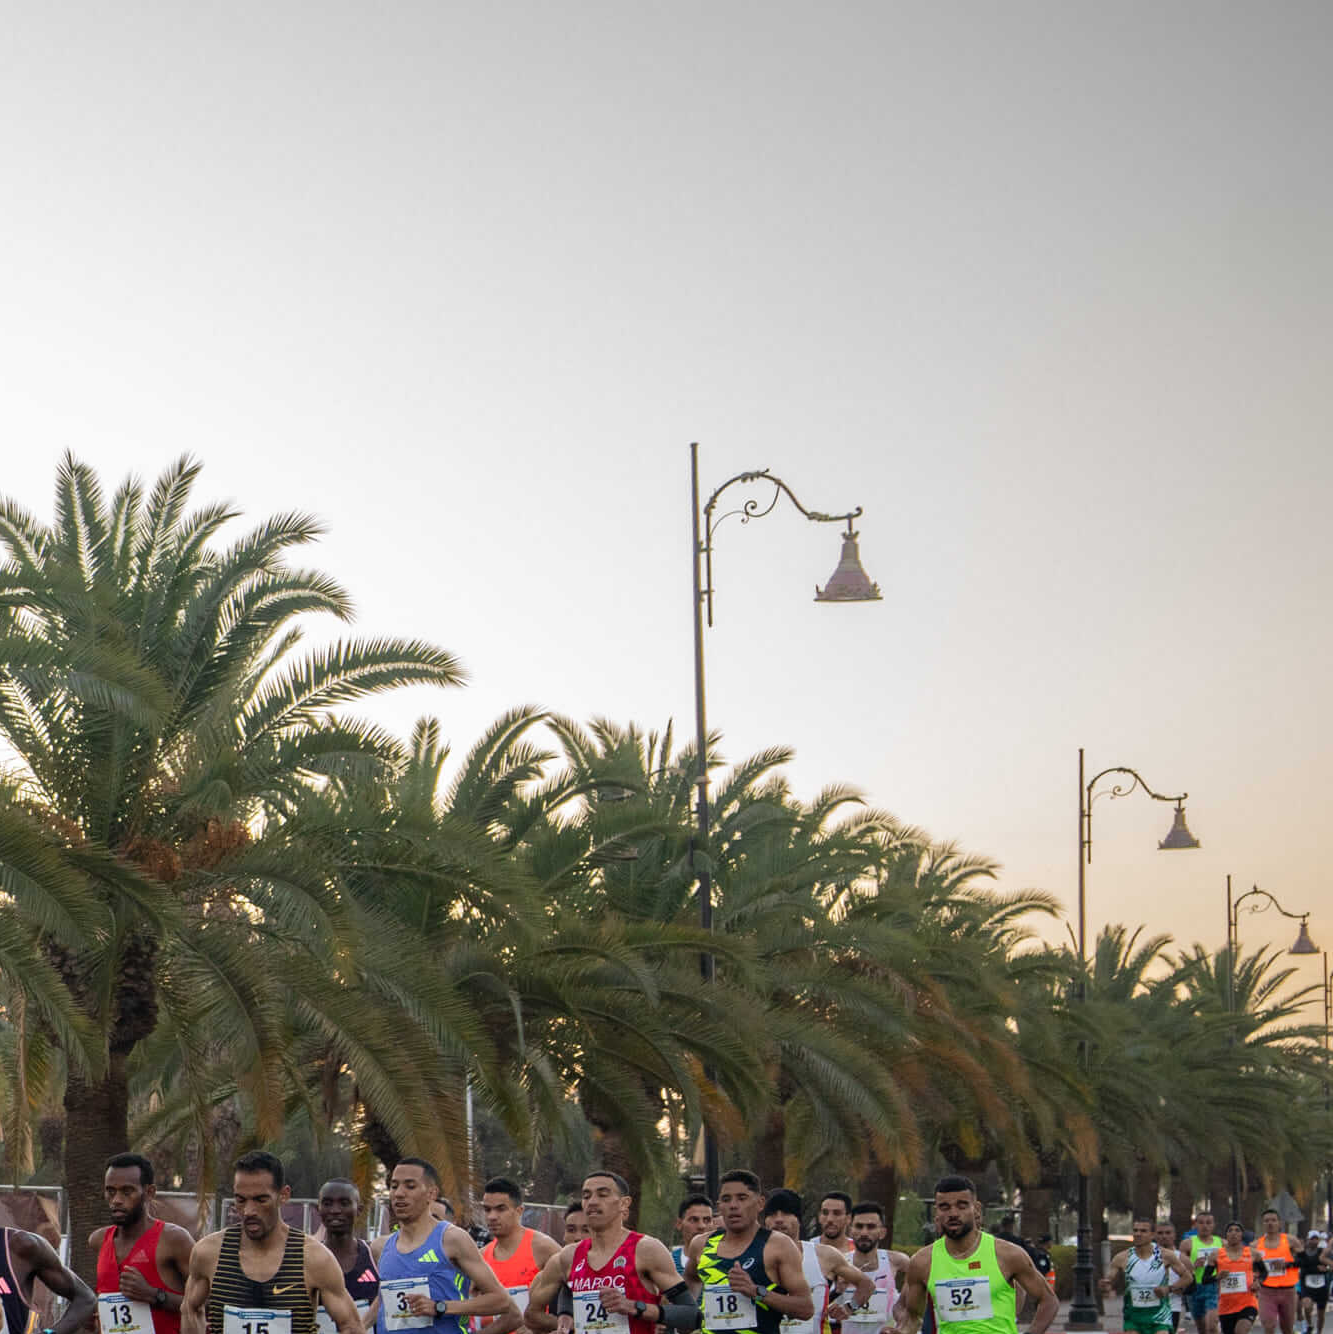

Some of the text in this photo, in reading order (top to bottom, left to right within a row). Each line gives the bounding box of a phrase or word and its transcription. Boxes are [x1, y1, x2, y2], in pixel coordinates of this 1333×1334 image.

[574, 1275, 625, 1290] MAROC
[396, 1292, 408, 1311] 3
[716, 1295, 737, 1312] 18
[951, 1288, 973, 1306] 52
[1139, 1290, 1150, 1299] 32
[110, 1304, 132, 1325] 13
[586, 1303, 608, 1322] 24
